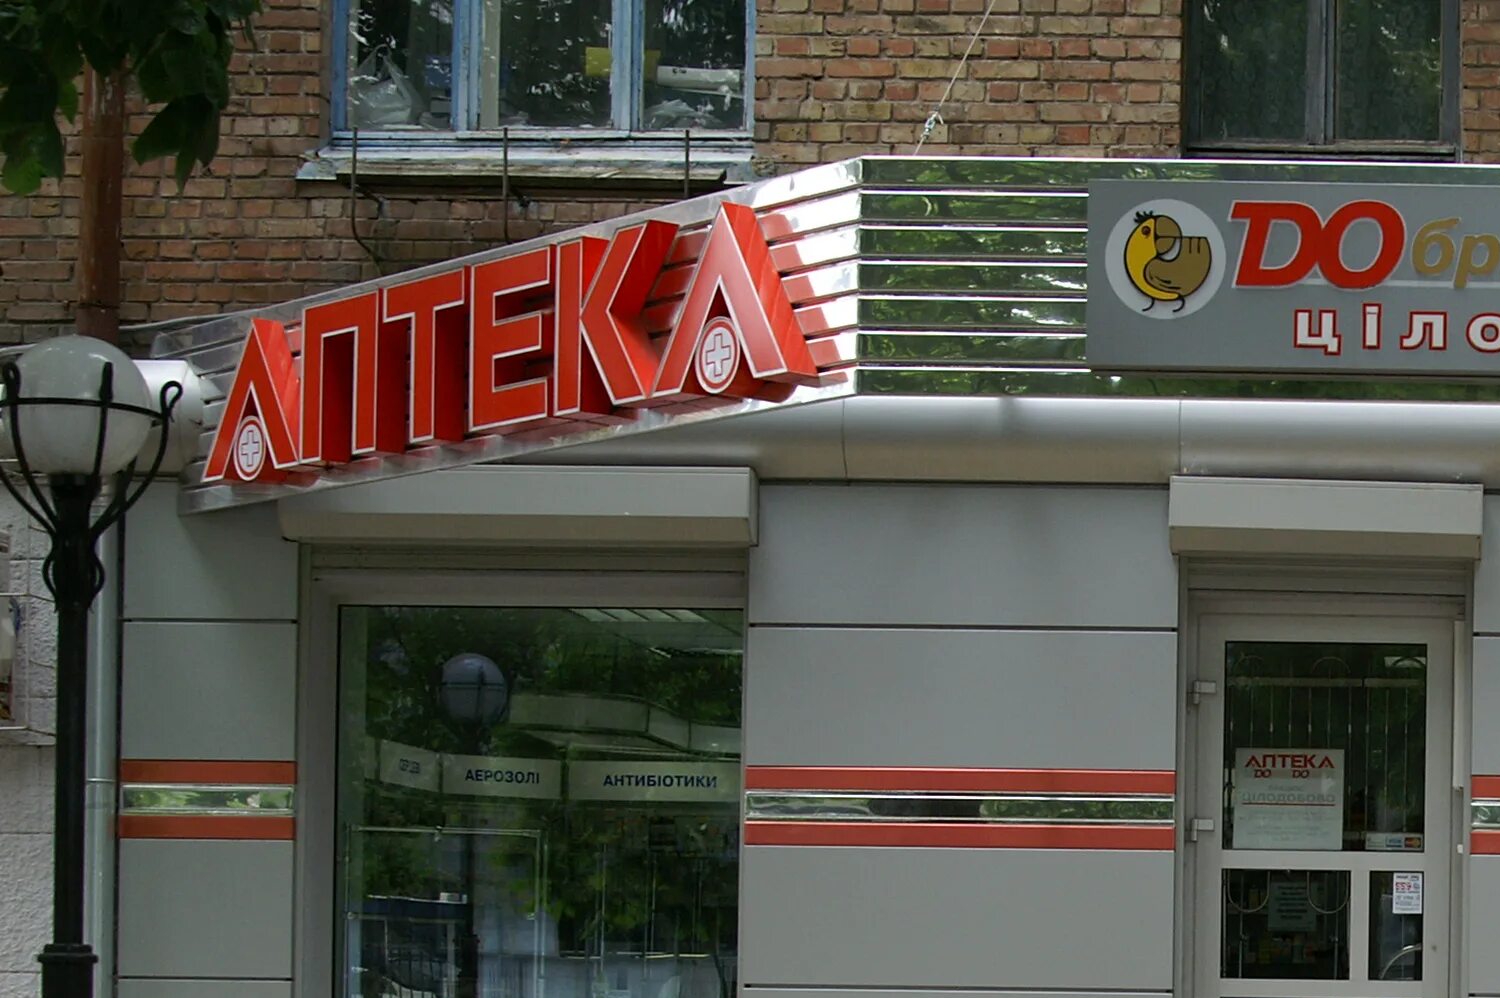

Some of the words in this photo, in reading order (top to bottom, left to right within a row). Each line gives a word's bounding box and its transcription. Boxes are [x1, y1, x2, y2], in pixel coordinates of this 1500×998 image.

[203, 201, 800, 482] АПТЕКА
[1245, 754, 1335, 768] АПТЕКА
[464, 769, 540, 785] АЕРОЗОЛІ
[602, 774, 718, 789] АНТИБІОТИКИ
